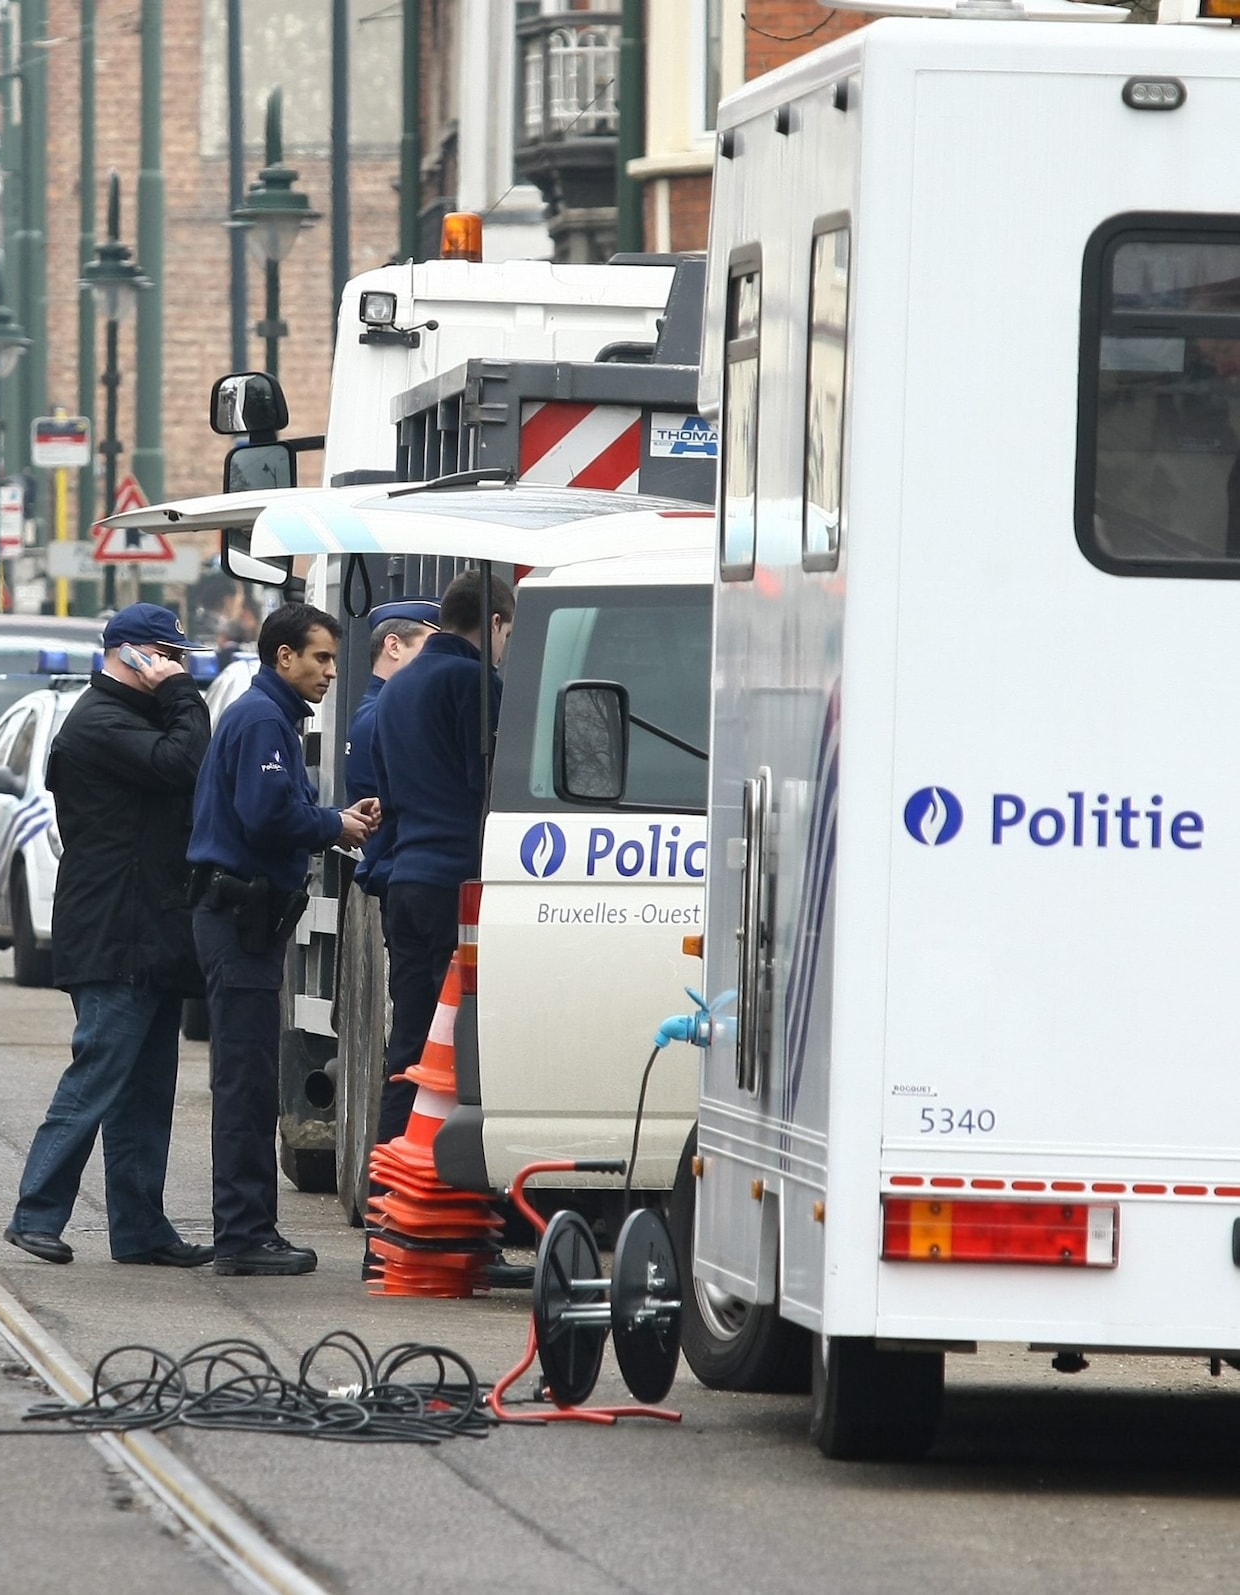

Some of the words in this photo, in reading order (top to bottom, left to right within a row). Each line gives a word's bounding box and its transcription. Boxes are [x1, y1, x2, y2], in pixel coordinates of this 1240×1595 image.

[991, 791, 1205, 850] Politie
[537, 902, 628, 924] Bruxelles
[920, 1107, 996, 1134] 5340
